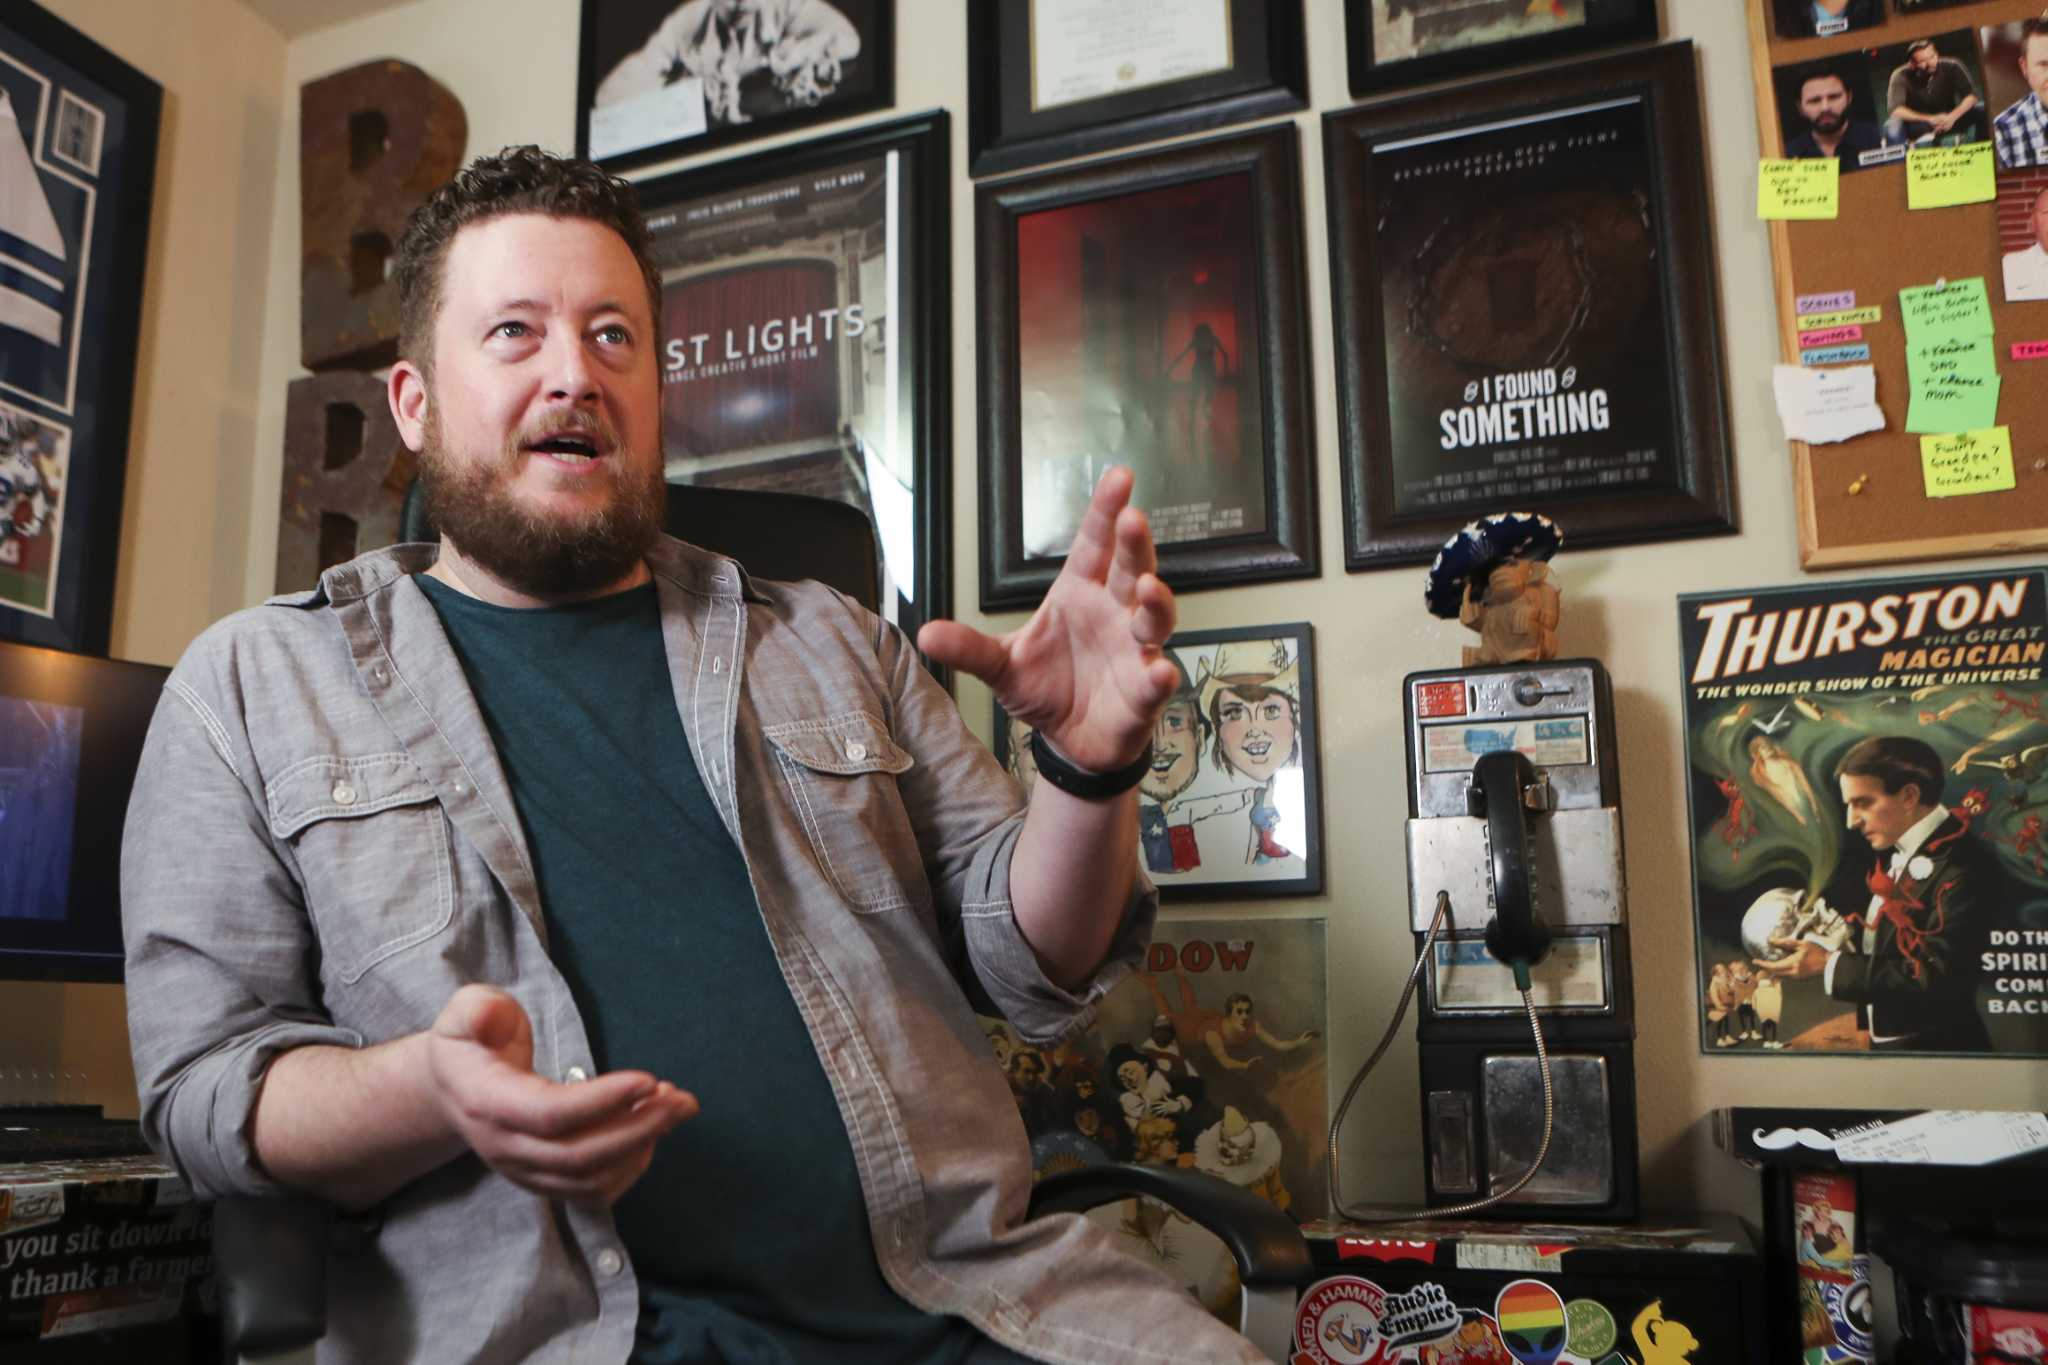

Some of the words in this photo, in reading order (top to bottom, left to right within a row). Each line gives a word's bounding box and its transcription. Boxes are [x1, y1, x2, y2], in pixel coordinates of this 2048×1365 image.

[726, 304, 866, 360] LIGHTS
[752, 350, 786, 369] SHORT
[791, 345, 819, 361] FILM
[1483, 377, 1490, 403] I
[1496, 368, 1558, 401] FOUND
[1440, 388, 1610, 450] SOMETHING
[1692, 579, 2029, 684] THURSTON
[1924, 635, 1960, 646] THE
[1965, 626, 2042, 643] GREAT
[1879, 642, 2046, 672] MAGICIAN
[1696, 686, 1731, 699] THE
[1735, 679, 1811, 697] WONDER
[1815, 677, 1871, 693] SHOW
[1871, 675, 1896, 689] OF
[1900, 672, 1938, 688] THE
[1942, 667, 2042, 685] UNIVERSE
[1990, 930, 2020, 946] DO
[1981, 952, 2048, 971] SPIRI
[1995, 978, 2048, 993] COM
[0, 1235, 57, 1269] you
[65, 1224, 102, 1254] sit
[108, 1221, 182, 1249] down
[10, 1262, 96, 1299] thank
[104, 1264, 119, 1285] a
[1378, 1304, 1455, 1336] Empire
